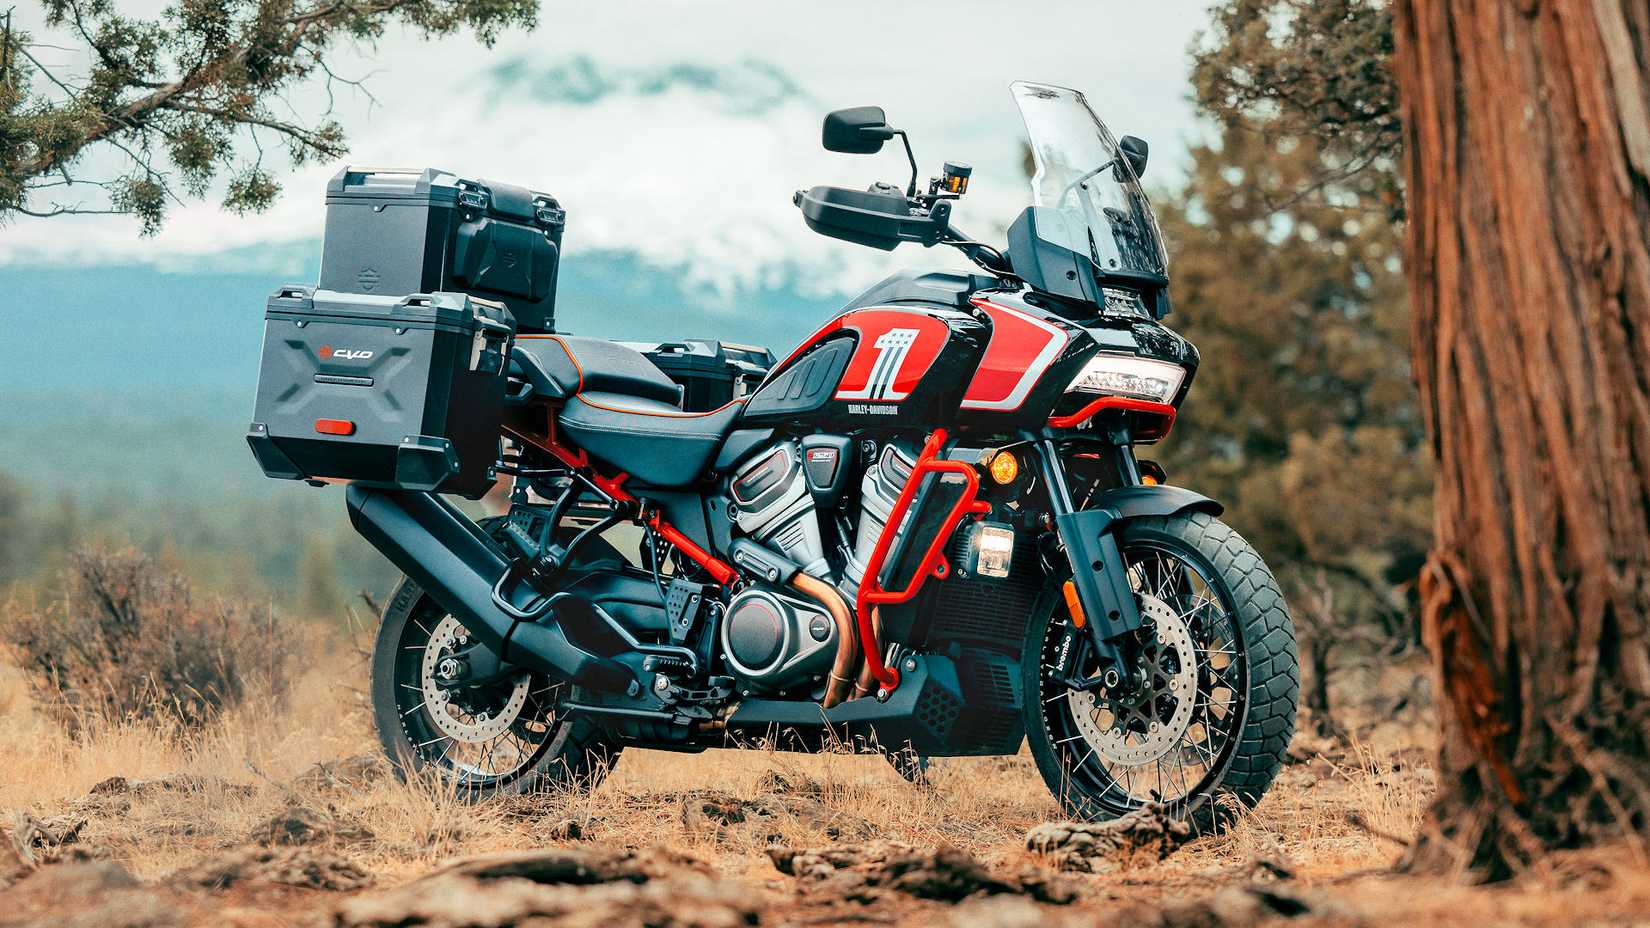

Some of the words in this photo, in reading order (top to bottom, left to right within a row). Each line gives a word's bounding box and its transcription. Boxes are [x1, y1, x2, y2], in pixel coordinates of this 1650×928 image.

[333, 349, 374, 359] CVO
[847, 404, 898, 415] HARLEY-DAVIDSON
[1055, 635, 1072, 671] brembo
